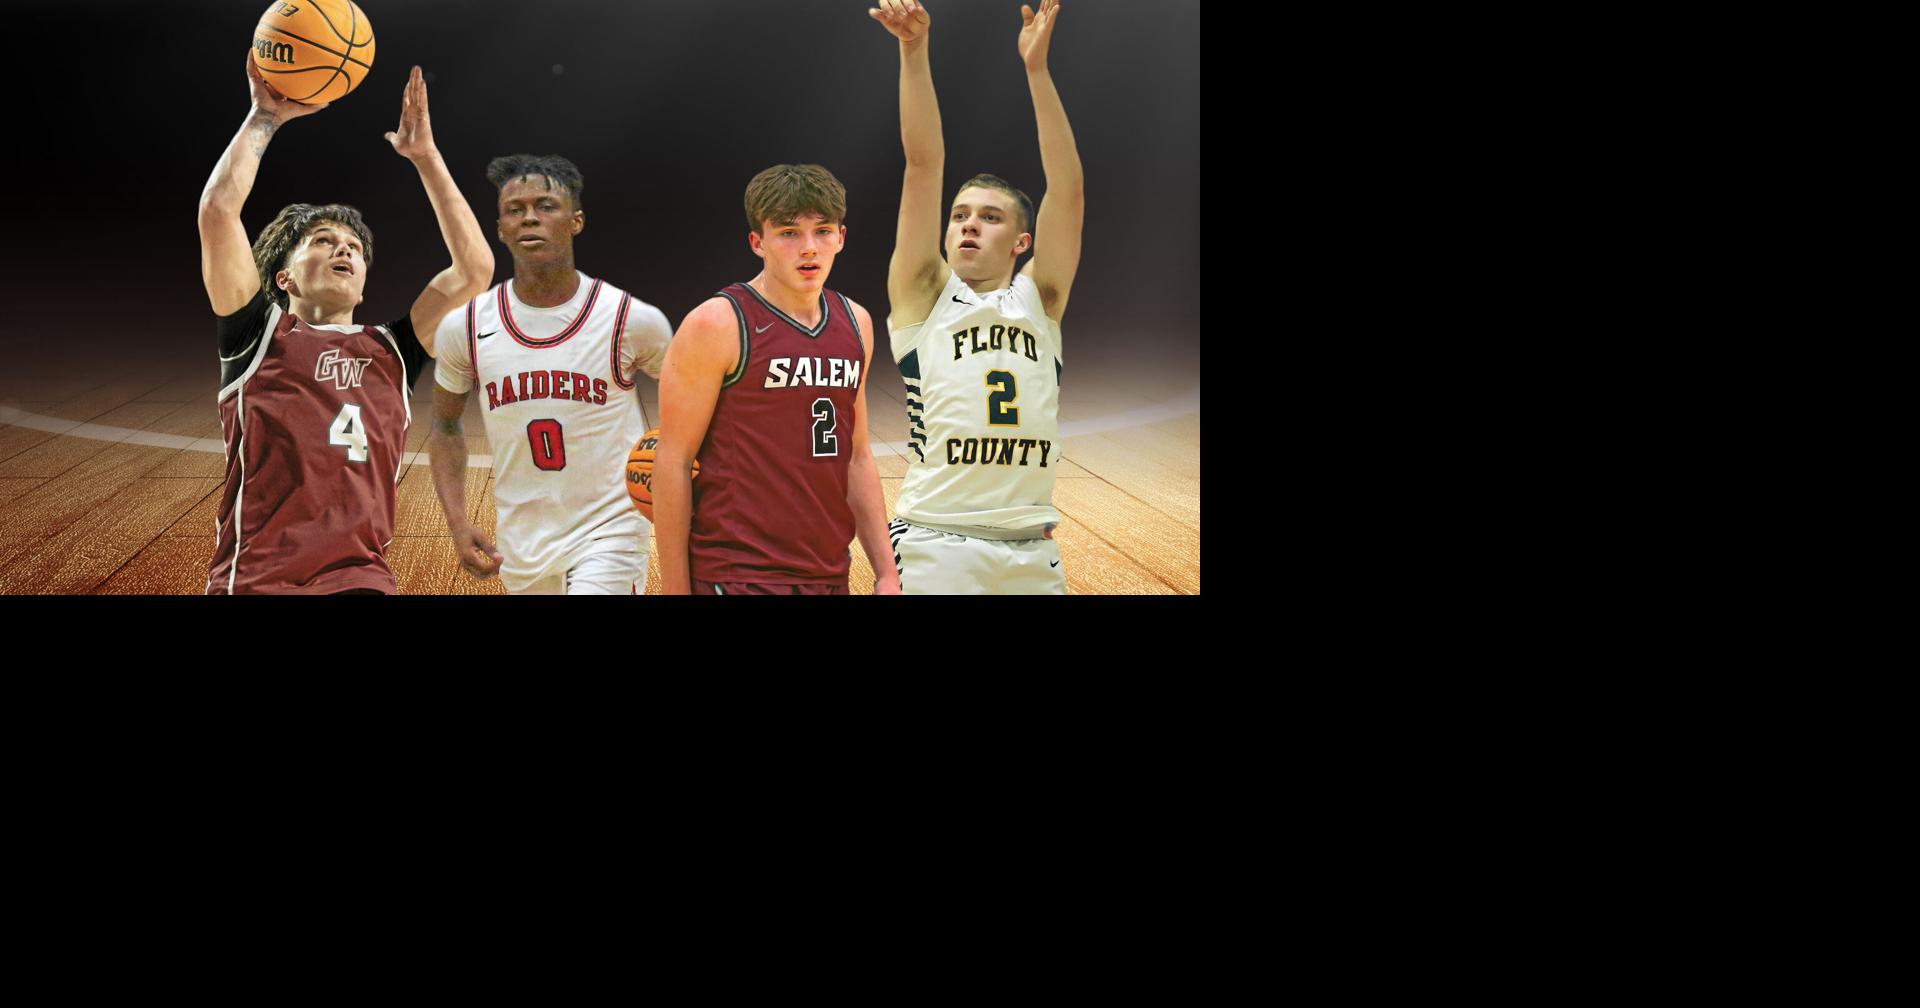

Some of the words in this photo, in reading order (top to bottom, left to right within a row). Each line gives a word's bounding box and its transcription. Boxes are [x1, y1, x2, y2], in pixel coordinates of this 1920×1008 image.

[253, 38, 295, 65] Wils
[953, 324, 1038, 362] FLOYD
[314, 349, 373, 390] GW
[764, 356, 860, 389] SALEM
[485, 370, 608, 411] RAIDERS
[984, 368, 1020, 427] 2
[328, 402, 369, 463] 4
[812, 397, 838, 457] 2
[946, 437, 1051, 468] COUNTY
